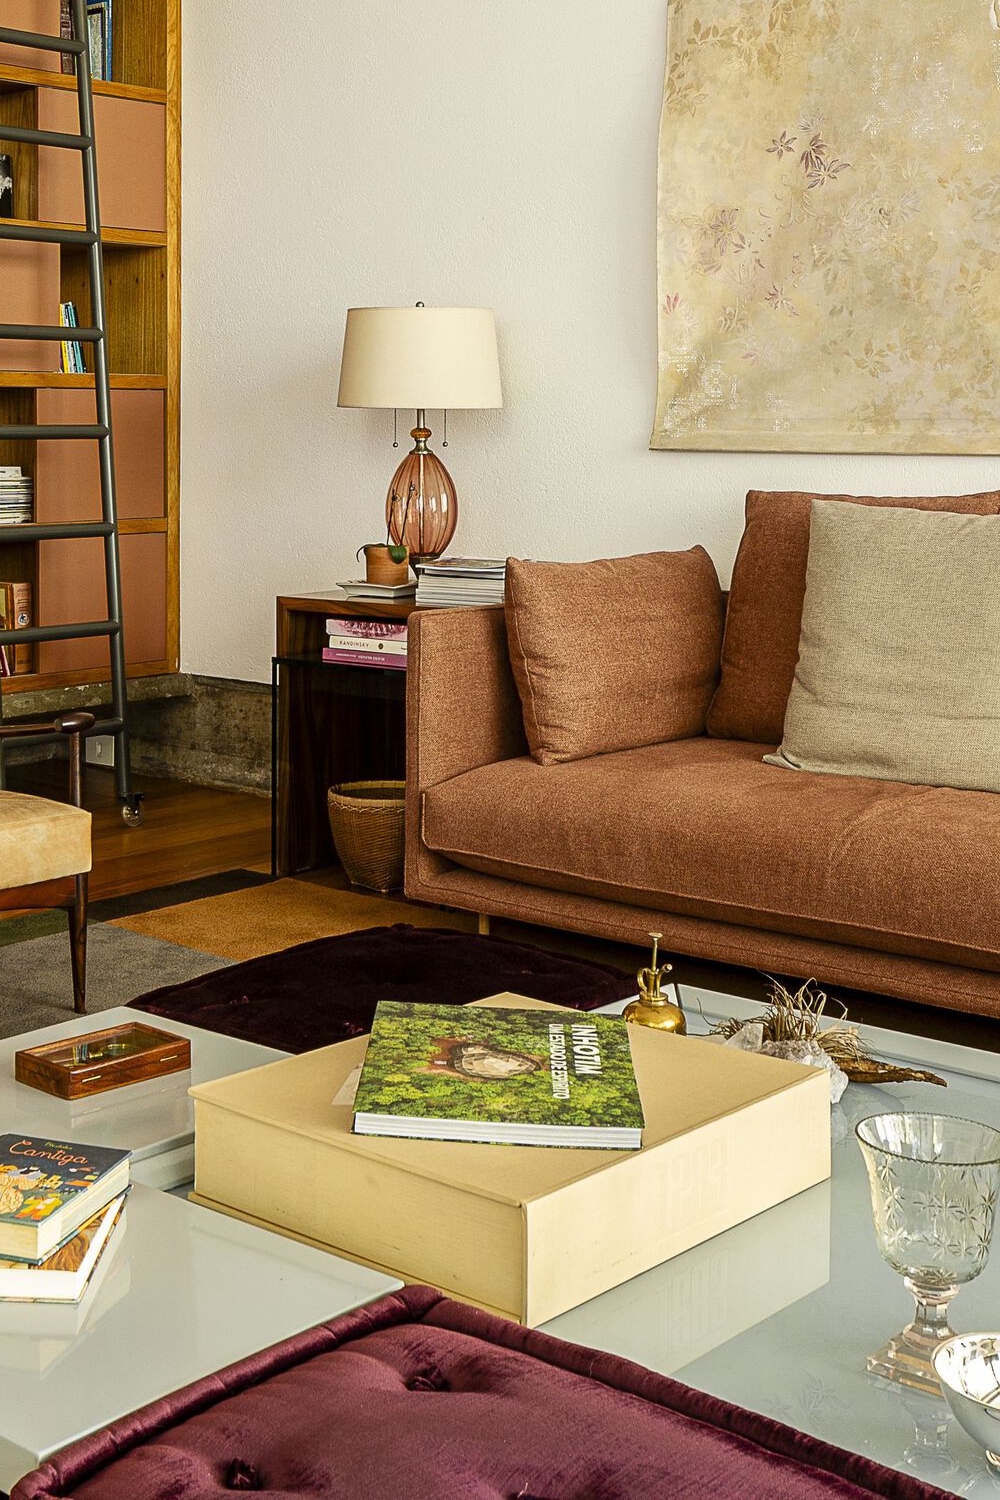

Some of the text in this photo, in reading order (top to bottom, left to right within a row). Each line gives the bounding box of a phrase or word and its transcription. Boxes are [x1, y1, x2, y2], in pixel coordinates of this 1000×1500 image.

[548, 1024, 573, 1099] UM ESTADO DE ESPÍRITO
[571, 1025, 603, 1074] INHOTIM
[9, 1140, 88, 1166] Cantiga
